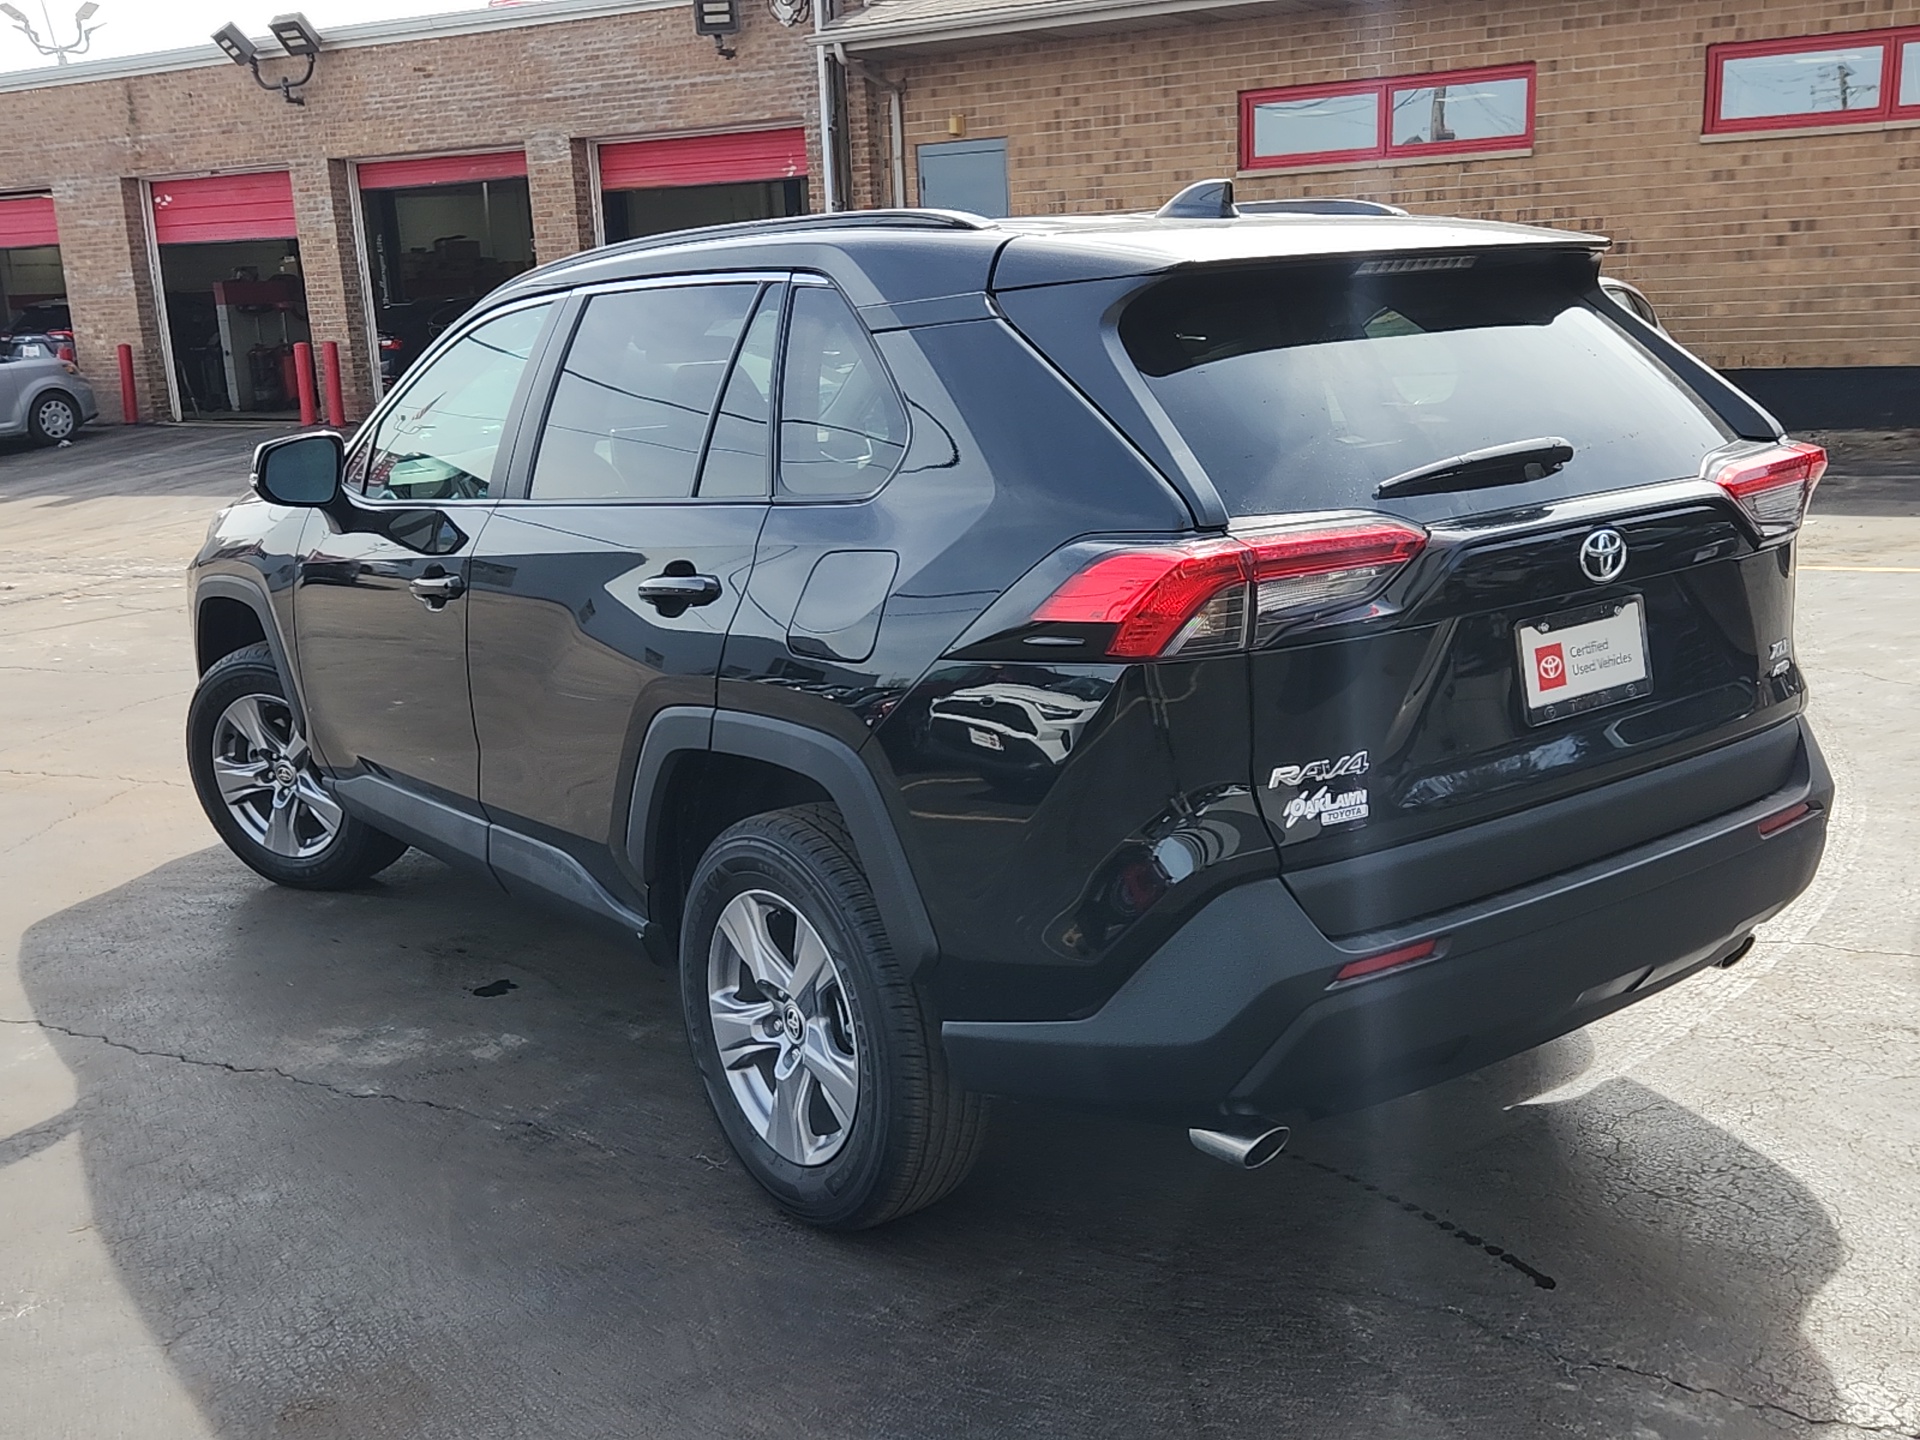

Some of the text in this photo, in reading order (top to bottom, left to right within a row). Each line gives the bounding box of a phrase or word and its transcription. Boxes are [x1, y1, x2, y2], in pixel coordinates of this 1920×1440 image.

[1569, 638, 1609, 658] Certified
[1572, 652, 1632, 676] Used Vehicles
[1268, 751, 1369, 789] RAV4
[1327, 807, 1362, 820] TOYOTA
